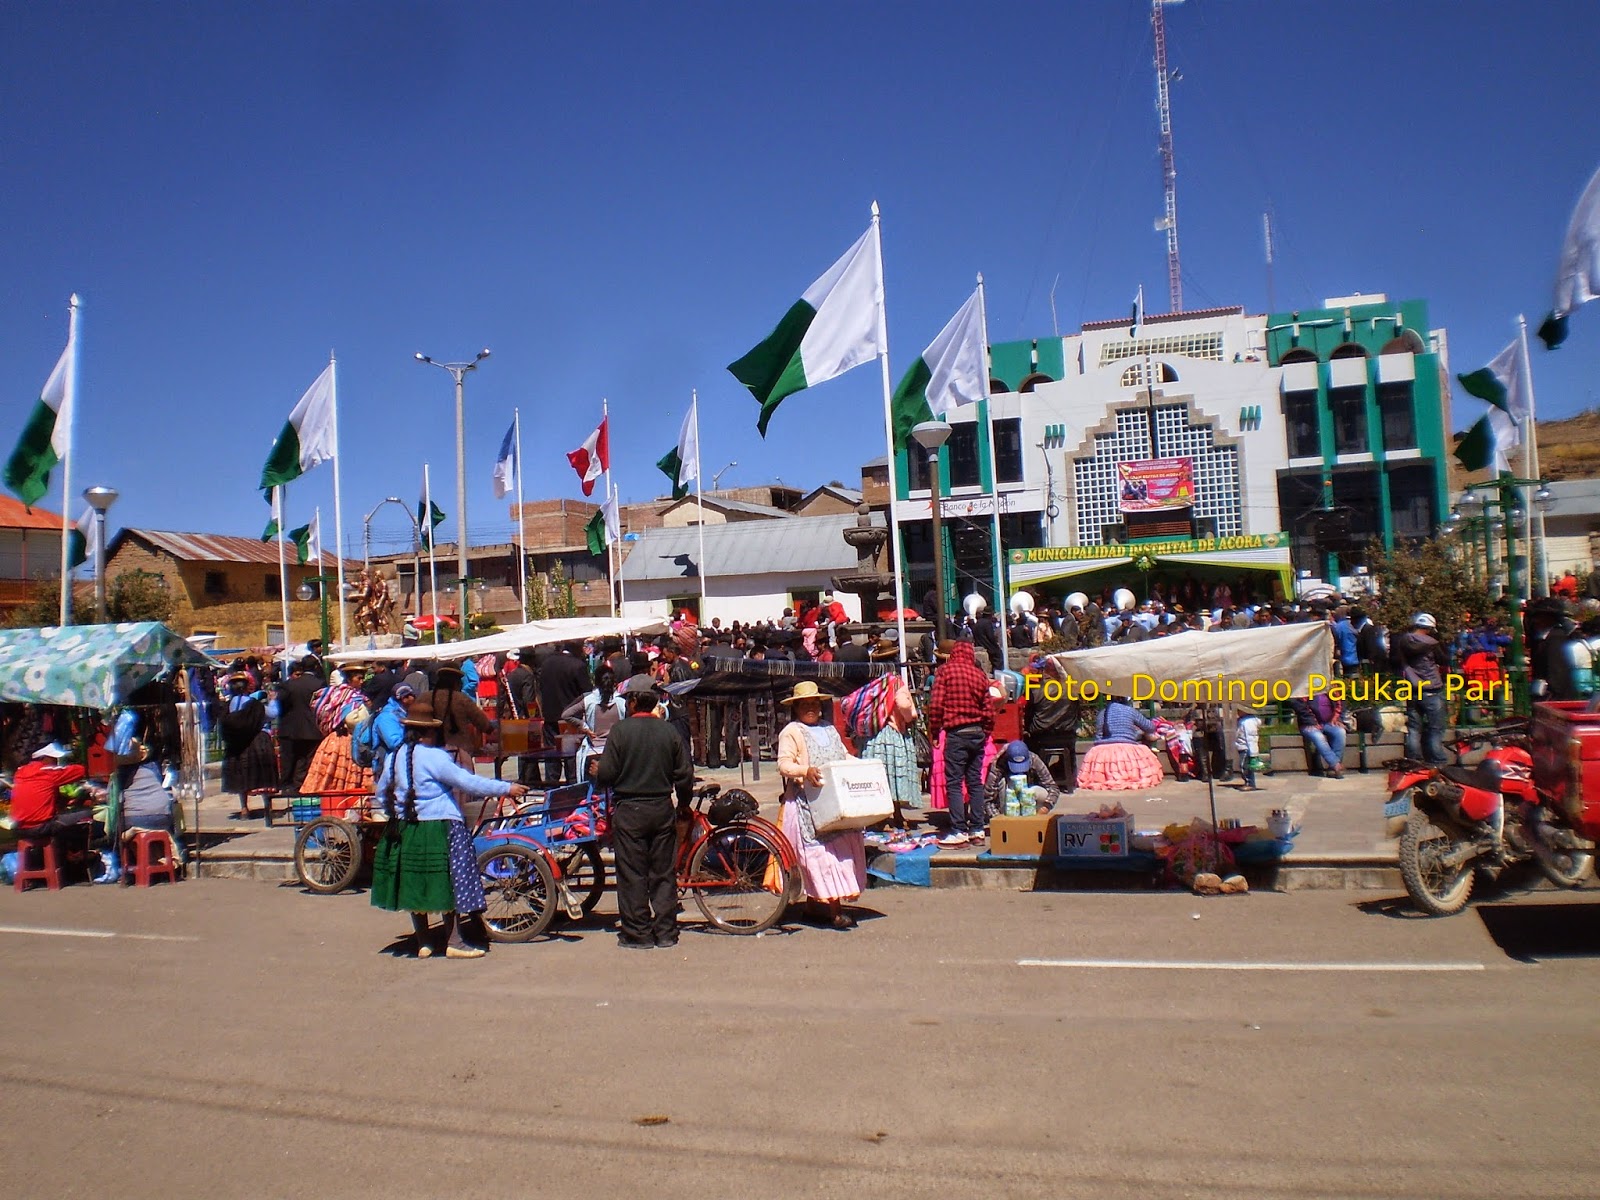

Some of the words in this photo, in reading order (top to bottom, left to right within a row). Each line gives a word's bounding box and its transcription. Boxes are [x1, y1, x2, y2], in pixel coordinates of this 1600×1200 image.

[1027, 545, 1125, 562] MUNICIPALIDAD
[1198, 538, 1215, 551] DE
[1218, 535, 1262, 550] ACORA
